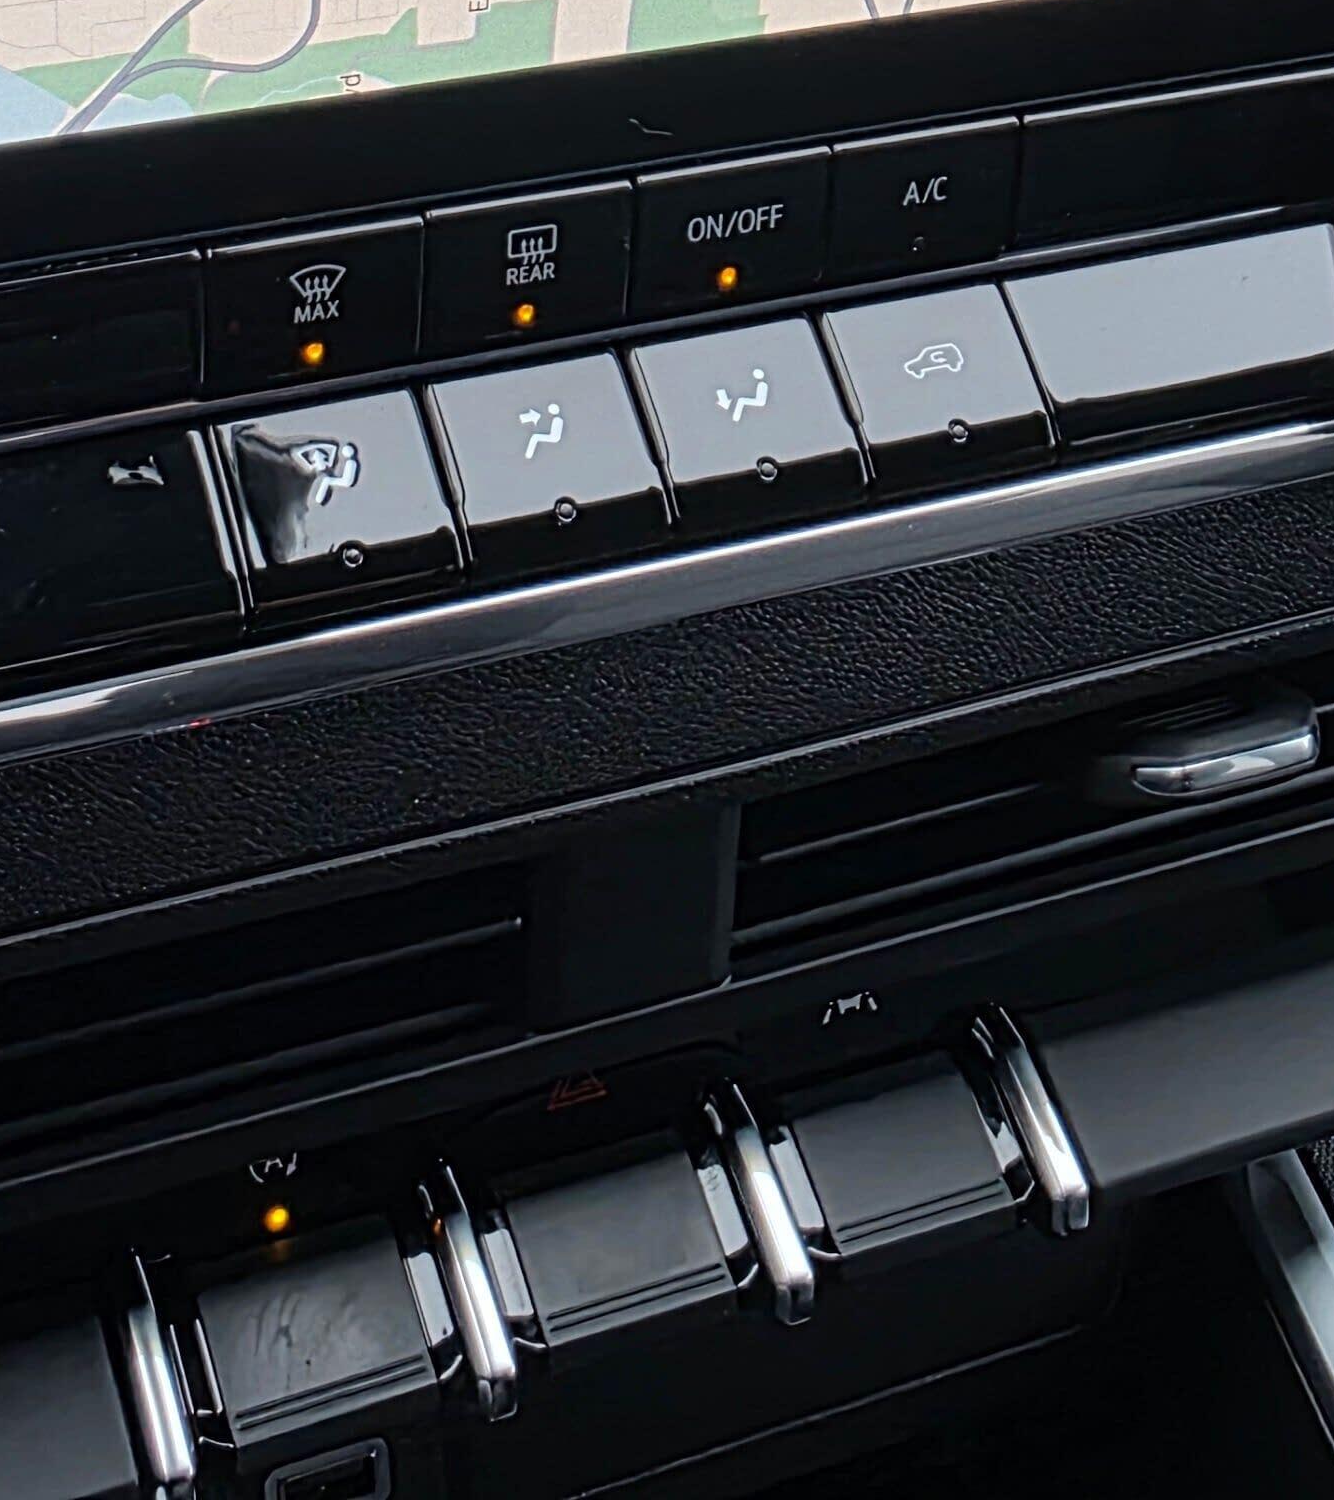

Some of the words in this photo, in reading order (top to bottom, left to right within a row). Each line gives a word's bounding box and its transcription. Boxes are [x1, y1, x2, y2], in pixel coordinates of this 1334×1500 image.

[903, 177, 948, 206] A/C
[687, 204, 784, 243] ON/OFF
[506, 262, 556, 285] REAR
[293, 300, 340, 323] MAX
